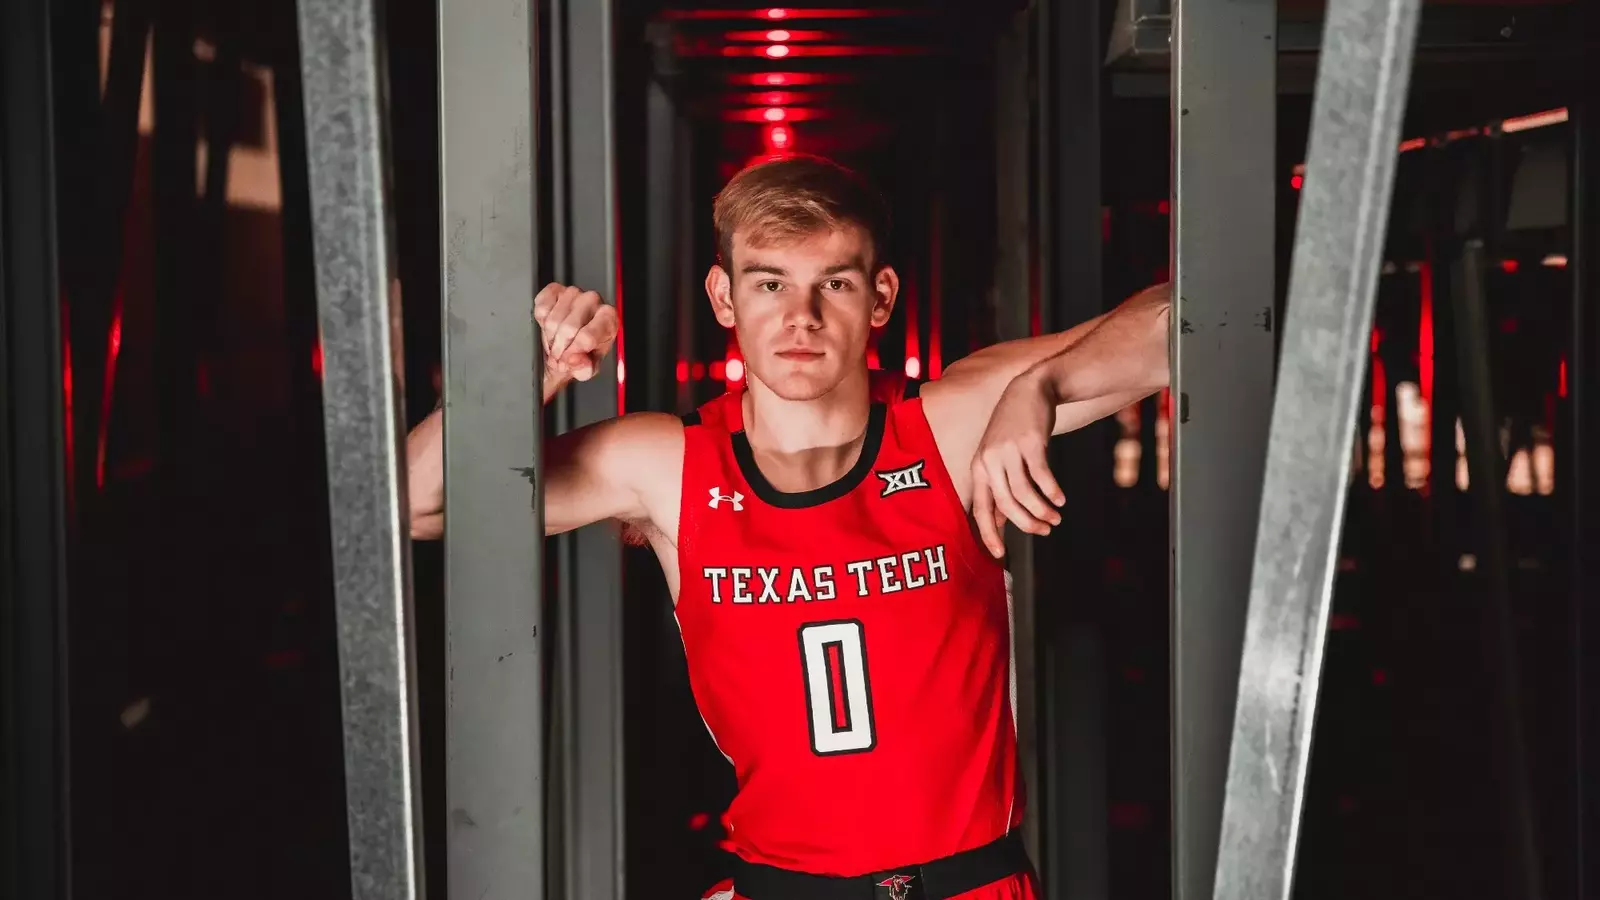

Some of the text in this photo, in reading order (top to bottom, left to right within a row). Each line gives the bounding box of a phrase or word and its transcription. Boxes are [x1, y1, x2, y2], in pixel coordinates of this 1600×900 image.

[704, 546, 949, 603] TEXAS TECH
[798, 619, 876, 756] 0
